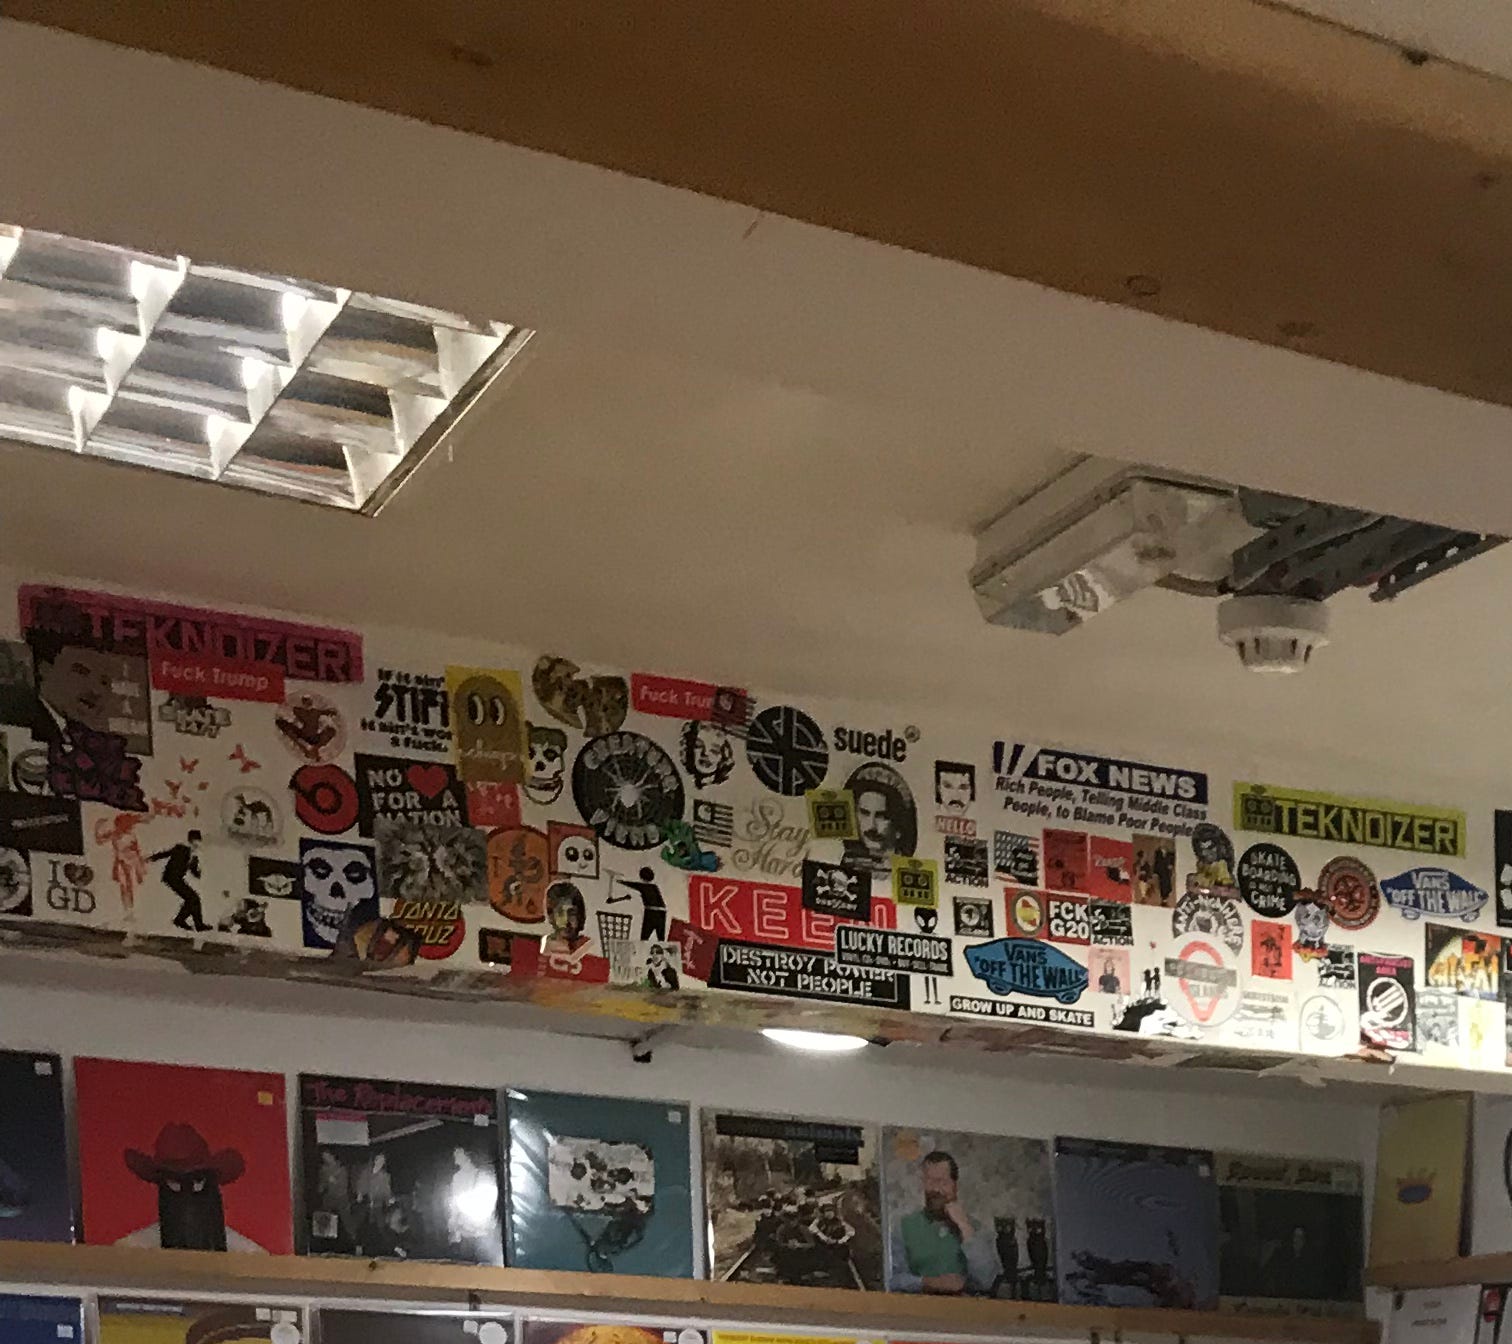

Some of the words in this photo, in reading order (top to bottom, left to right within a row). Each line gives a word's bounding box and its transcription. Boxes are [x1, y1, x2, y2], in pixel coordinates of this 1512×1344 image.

[160, 661, 207, 684] Fuck
[211, 667, 270, 691] Trump
[639, 685, 678, 704] Fuck
[833, 726, 907, 763] suede
[368, 768, 402, 788] NO
[995, 776, 1026, 793] Rich
[1037, 753, 1101, 785] FOX
[1107, 765, 1198, 799] NEWS
[372, 791, 422, 810] FOR
[442, 788, 461, 807] A
[1056, 804, 1071, 820] to
[1073, 808, 1115, 826] Blame
[1275, 800, 1455, 854] TEKNOIZER
[1411, 869, 1451, 890] VANS
[46, 885, 97, 914] GD
[1049, 902, 1089, 923] FCK
[1050, 920, 1090, 940] G20
[841, 928, 885, 953] LUCKY
[887, 934, 949, 961] RECORDS
[1004, 943, 1048, 966] VANS
[722, 946, 816, 974] DESTROY
[746, 968, 789, 988] NOT
[797, 972, 873, 999] PEOPLE
[1010, 961, 1041, 989] THE
[951, 998, 995, 1014] GROW
[995, 1002, 1016, 1017] UP
[1016, 1005, 1048, 1021] AND
[1048, 1009, 1094, 1027] SKATE
